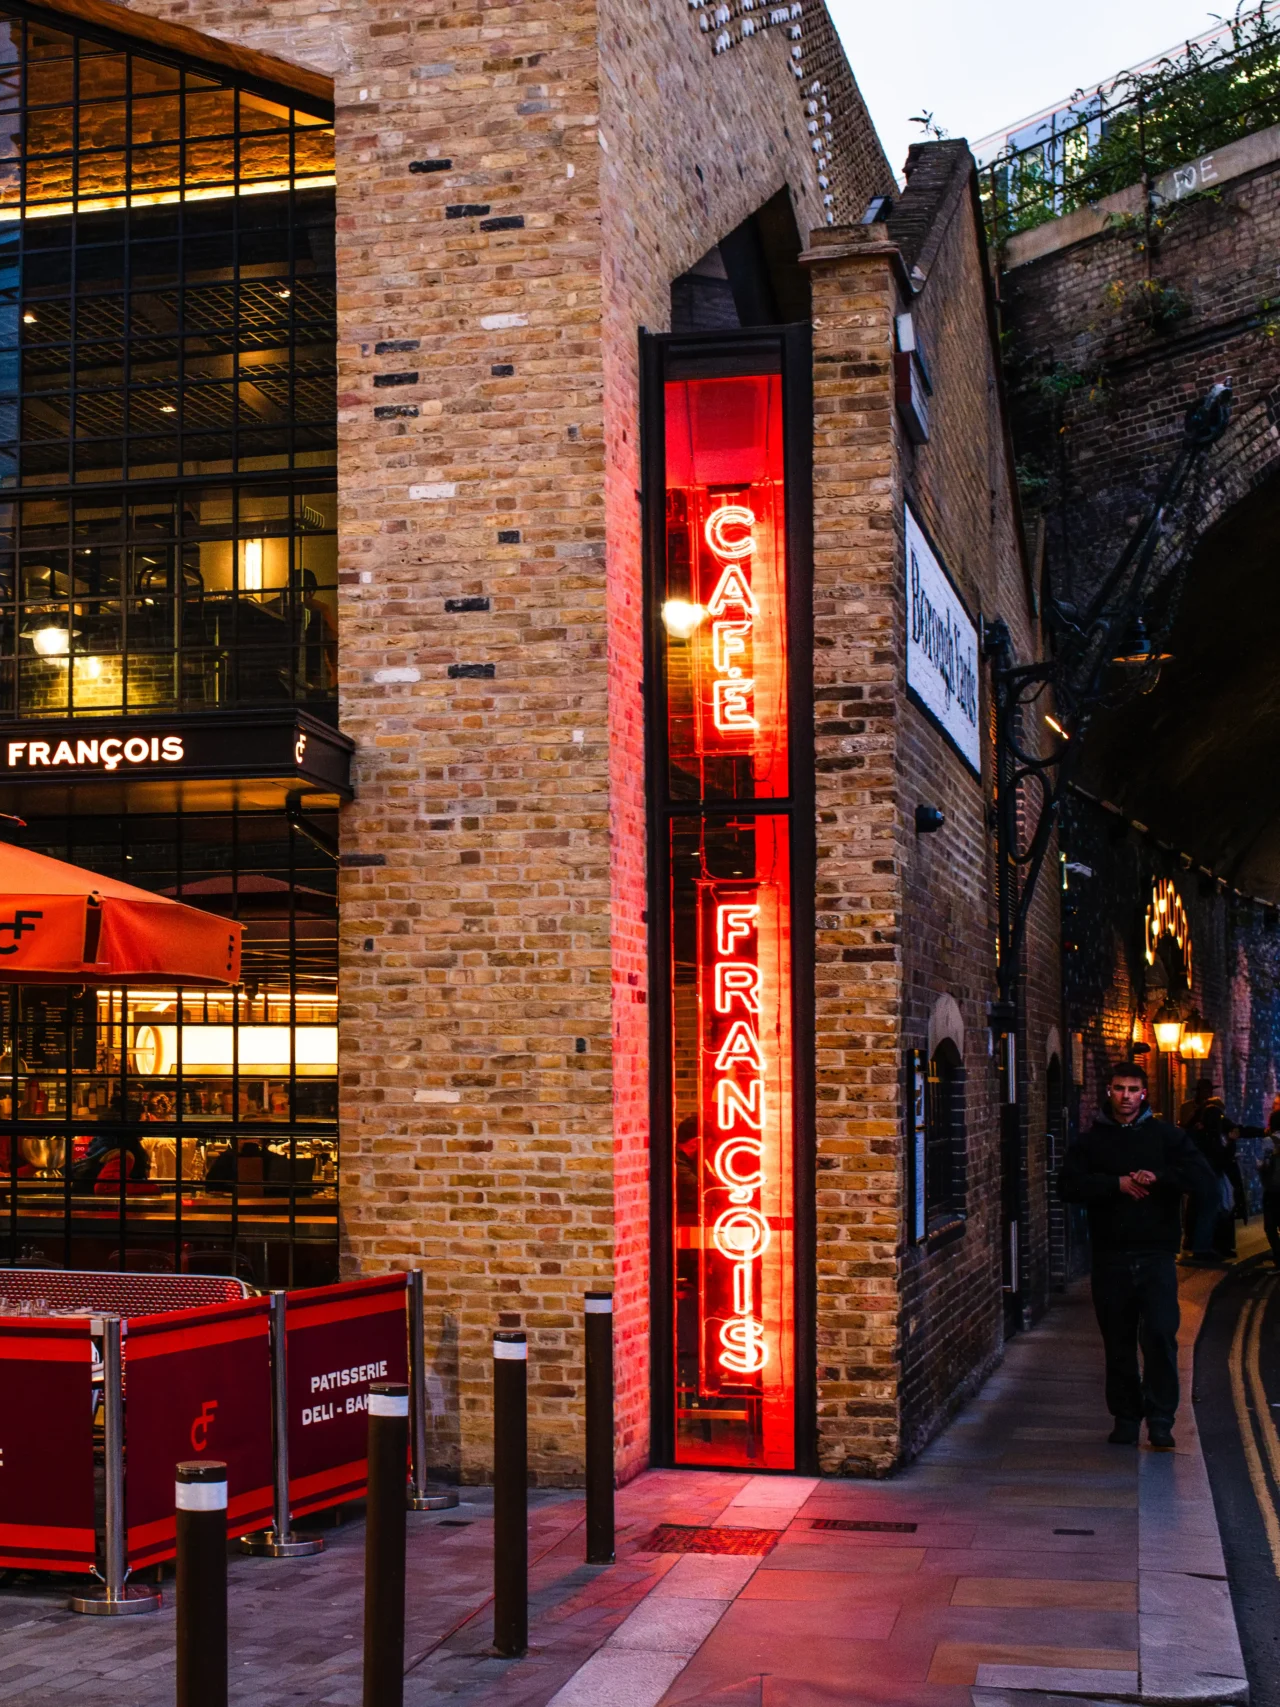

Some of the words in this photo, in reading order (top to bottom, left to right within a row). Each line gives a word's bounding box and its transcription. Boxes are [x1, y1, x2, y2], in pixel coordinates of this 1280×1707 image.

[8, 736, 185, 771] FRANÇOIS
[310, 1360, 388, 1394] PATISSERIE
[302, 1402, 334, 1426] DELI
